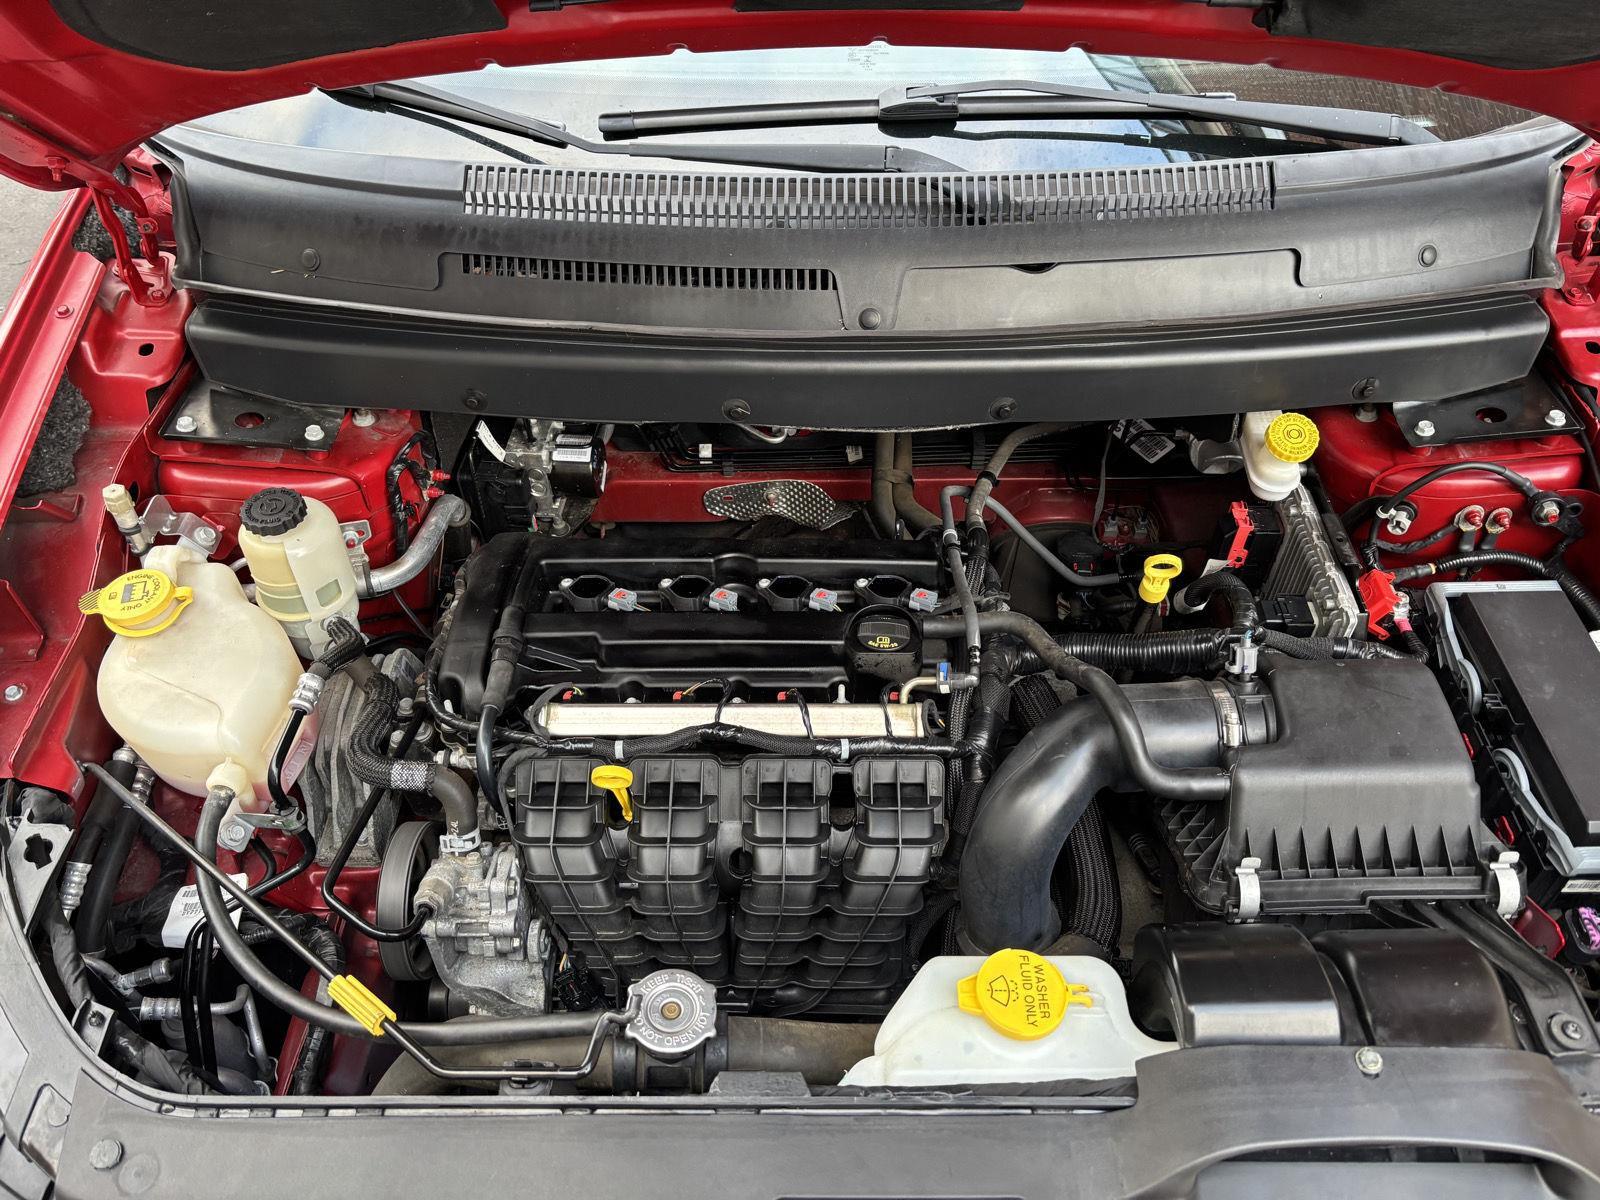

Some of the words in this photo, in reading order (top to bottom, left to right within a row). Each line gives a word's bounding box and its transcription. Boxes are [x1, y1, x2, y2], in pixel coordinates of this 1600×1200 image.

[127, 573, 153, 581] ENGINE
[120, 603, 143, 611] ONLY
[640, 974, 670, 995] KEEP
[675, 973, 705, 995] TIGHT
[1018, 954, 1033, 991] FLUID
[1033, 964, 1051, 1019] WASHER
[1024, 995, 1038, 1028] ONLY
[640, 1027, 663, 1043] NOT
[664, 1030, 697, 1046] OPEN
[693, 1011, 711, 1033] HOT
